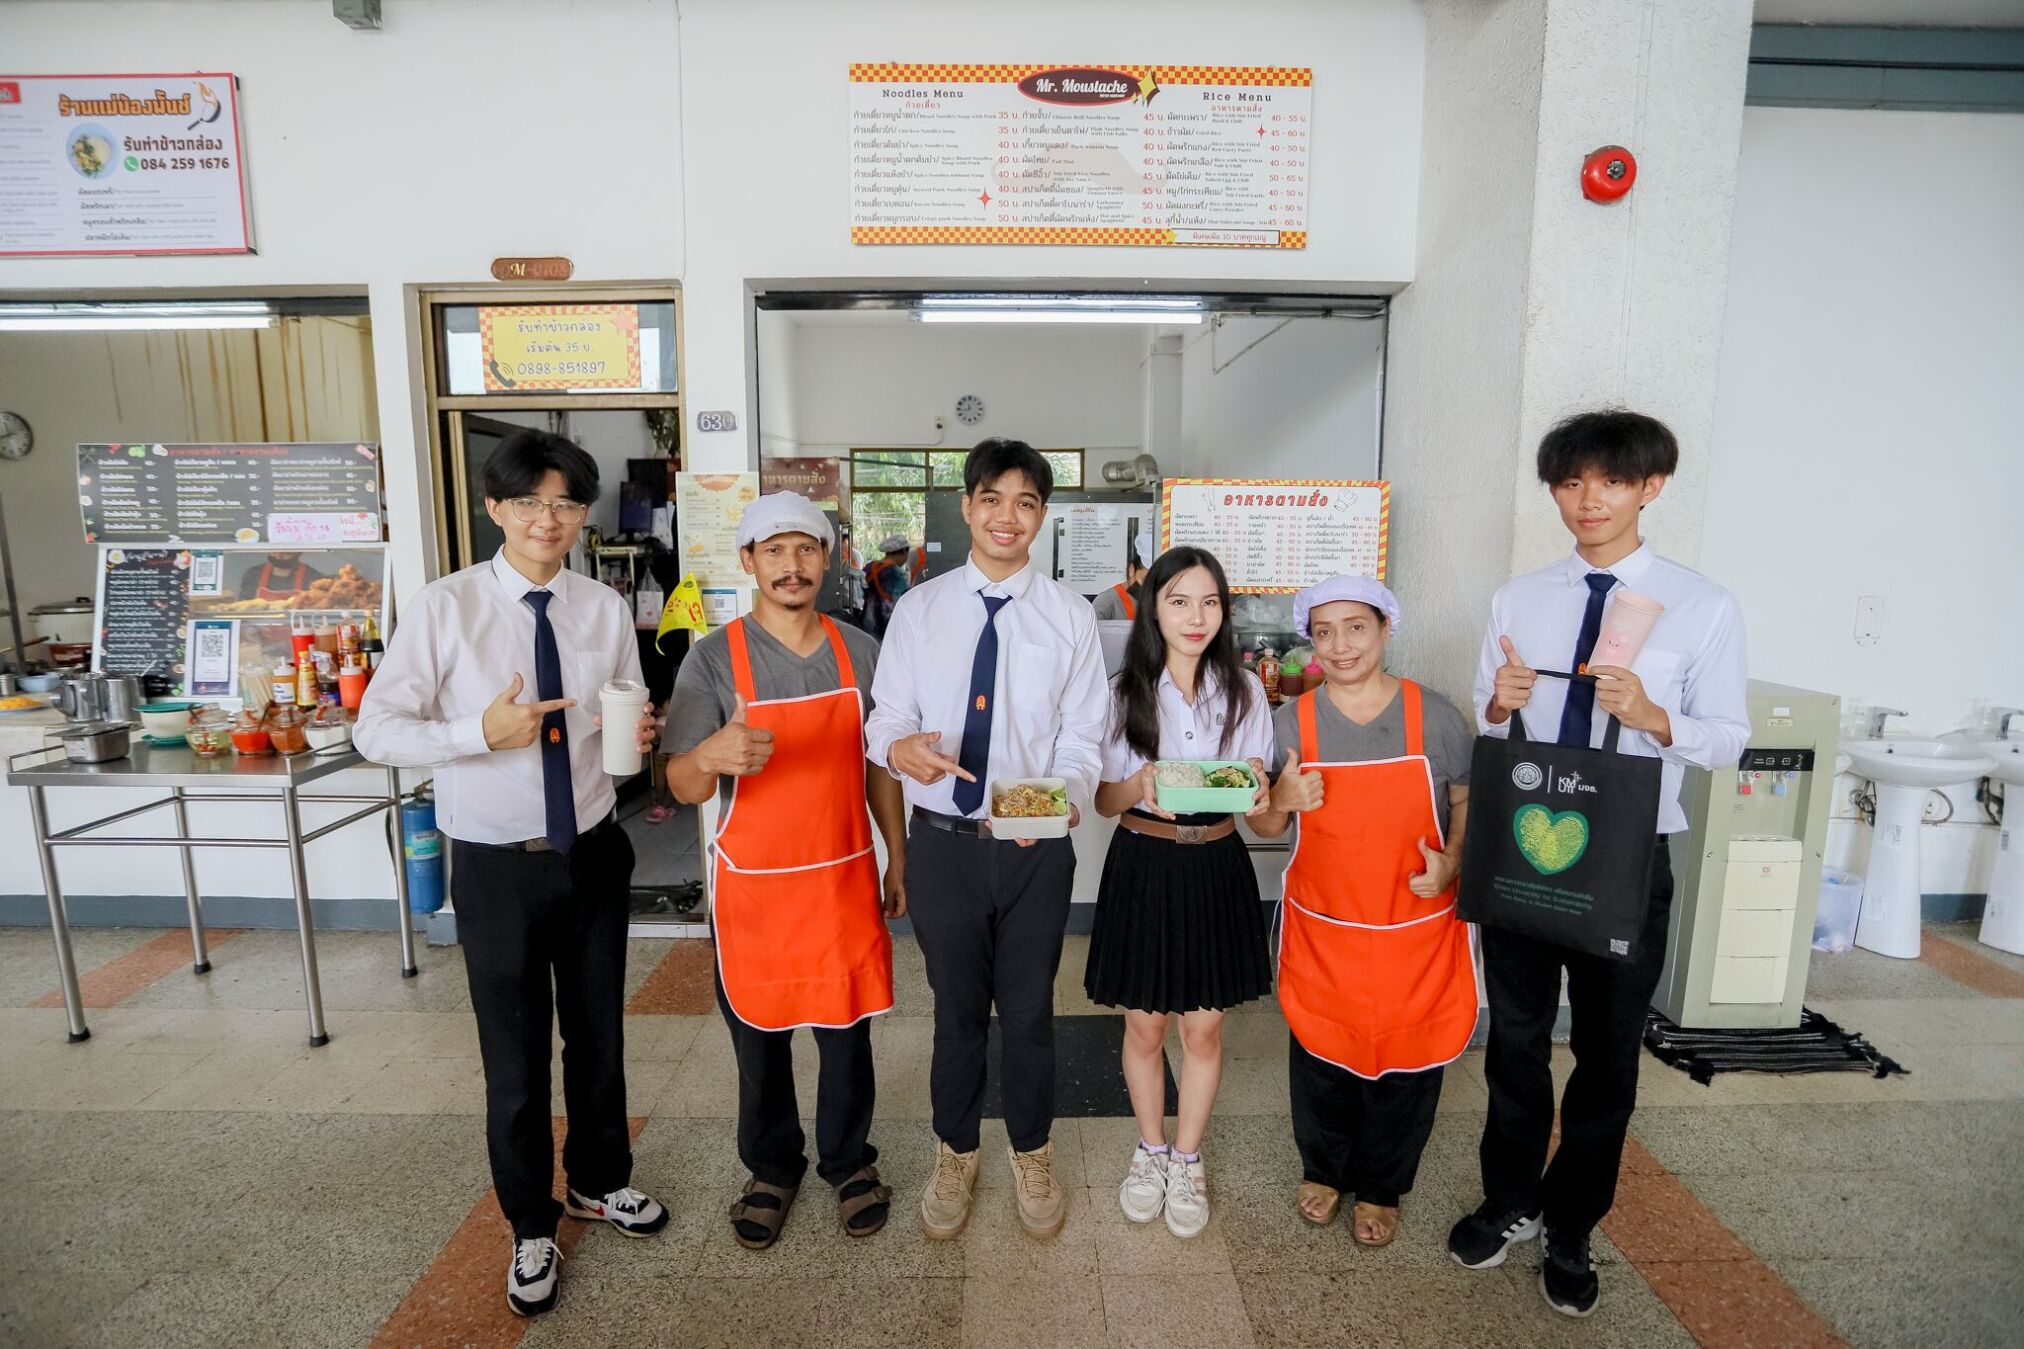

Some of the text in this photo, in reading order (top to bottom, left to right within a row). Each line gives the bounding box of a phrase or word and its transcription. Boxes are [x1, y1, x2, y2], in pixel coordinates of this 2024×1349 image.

[1036, 79, 1128, 93] Mr. Moustache
[882, 89, 964, 98] Noodles Menu
[1203, 92, 1272, 102] Rice Menu
[998, 126, 1009, 134] 35
[124, 135, 223, 152] รับทำข้าวกล่อง
[140, 158, 230, 170] 084 259 1676
[566, 342, 578, 352] 35
[517, 362, 606, 375] 0898-851897
[762, 468, 826, 484] าหารตามสั่ง
[1223, 489, 1328, 507] อาหารตามสั่ง
